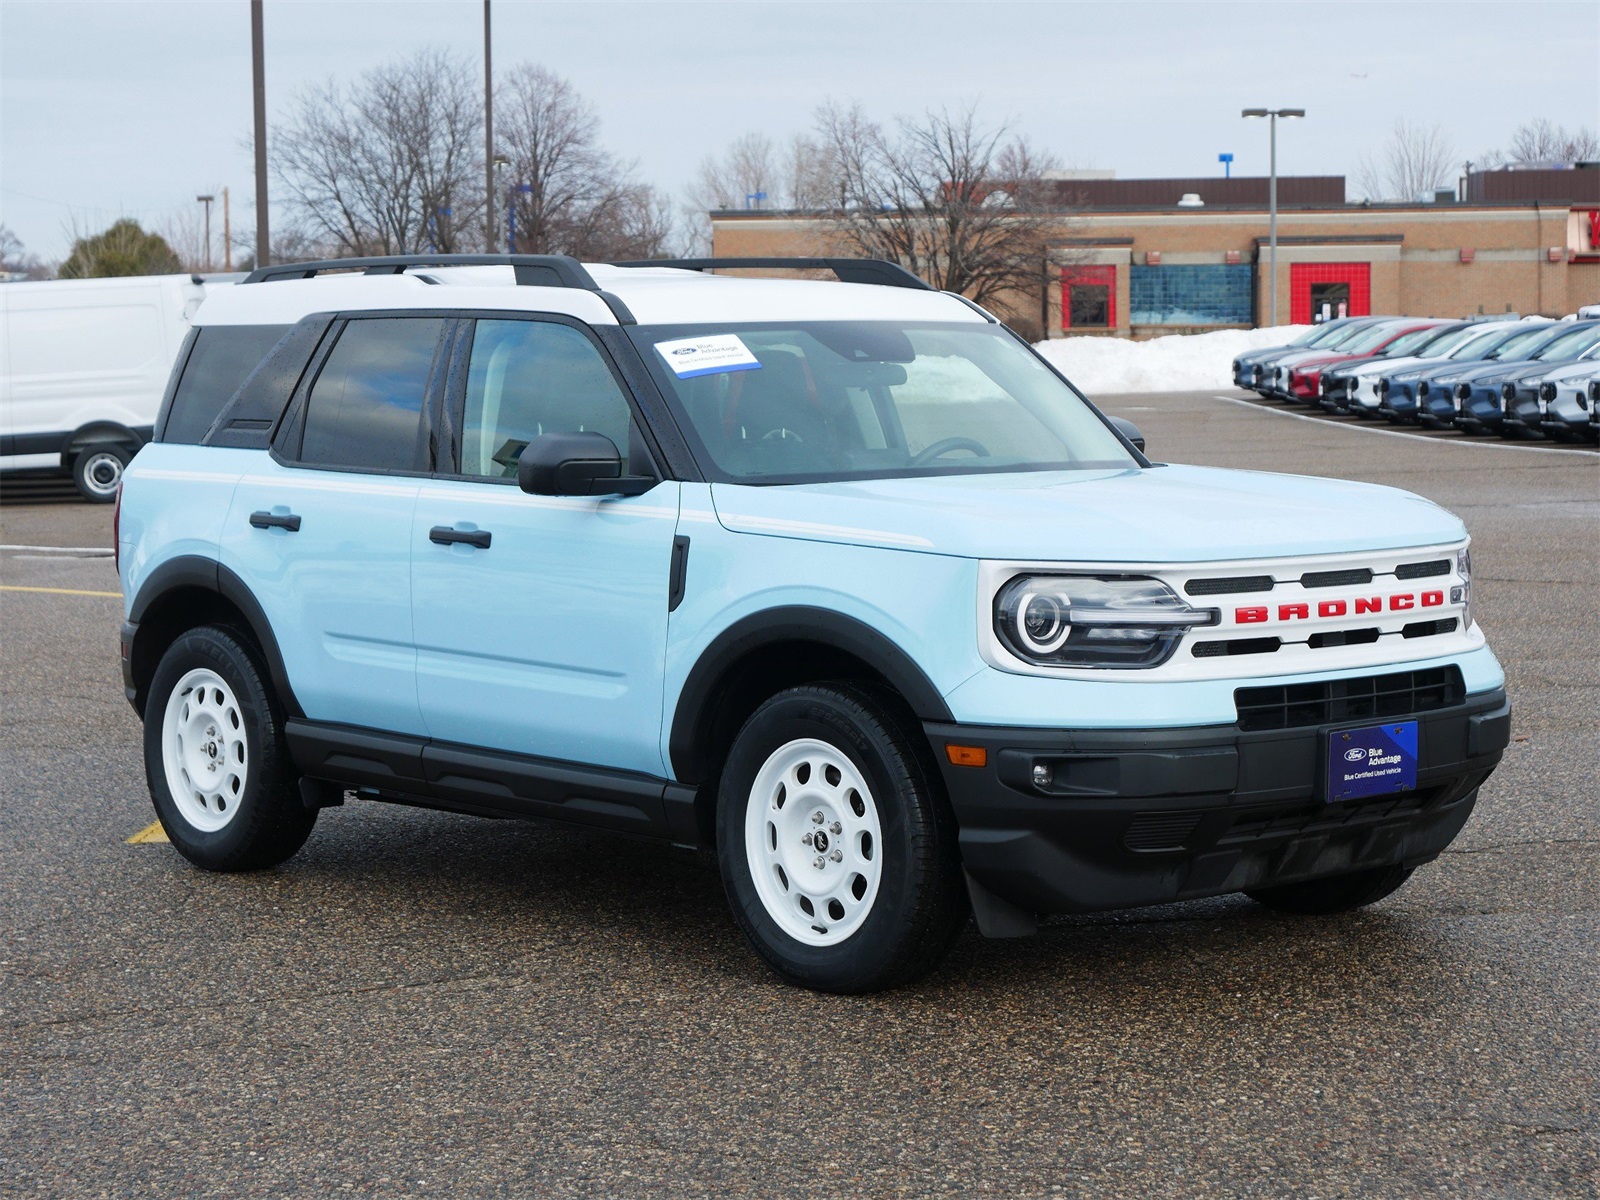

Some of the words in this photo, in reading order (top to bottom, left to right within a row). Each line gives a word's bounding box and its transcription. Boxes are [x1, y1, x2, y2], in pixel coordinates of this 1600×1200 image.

[1235, 590, 1443, 624] BRONCO
[1347, 749, 1365, 760] Ford
[1368, 748, 1383, 757] Blue
[1368, 754, 1402, 766] Advantage
[1354, 770, 1374, 779] Certified
[1374, 769, 1386, 777] Used
[1386, 767, 1402, 775] Vehicle
